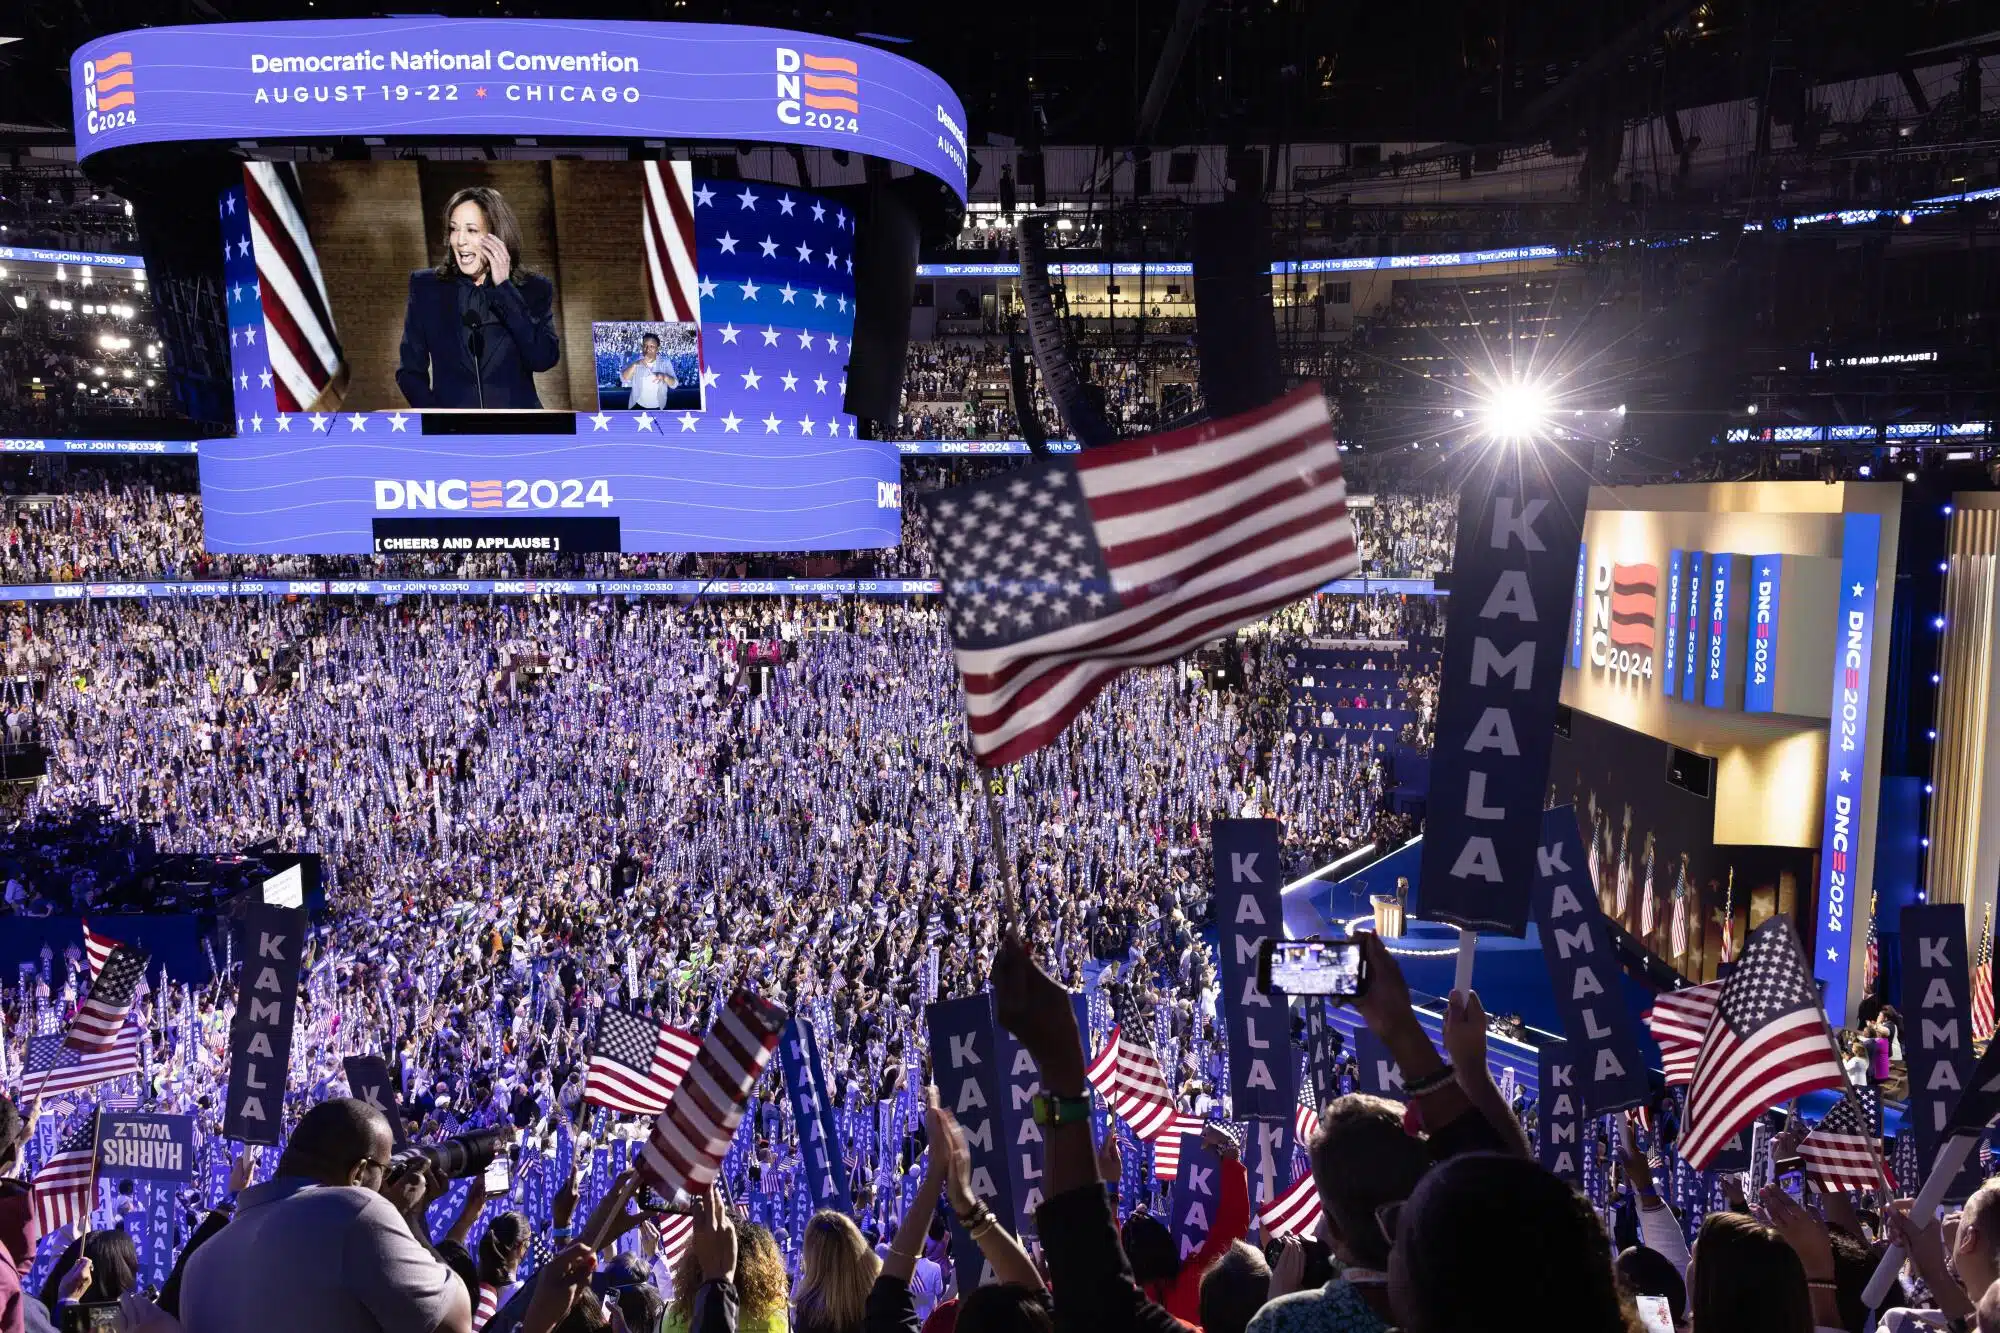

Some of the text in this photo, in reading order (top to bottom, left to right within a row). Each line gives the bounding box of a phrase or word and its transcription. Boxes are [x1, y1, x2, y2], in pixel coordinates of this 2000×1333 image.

[251, 49, 639, 74] Democratic National Convention
[84, 61, 137, 135] DNC 2024
[254, 84, 640, 104] AUGUST 19-22 CHICAGO
[776, 47, 859, 134] DNC 2024
[32, 251, 54, 260] Text
[55, 252, 80, 262] JOIN
[82, 254, 93, 262] to
[1070, 264, 1099, 274] 2024
[1392, 254, 1460, 267] DNC 2024
[1858, 355, 1879, 365] AND
[1881, 352, 1931, 364] APPLAUSE
[5, 440, 46, 450] 2024
[64, 441, 88, 450] Text
[90, 441, 115, 451] JOIN
[117, 442, 128, 451] to
[942, 441, 1010, 452] DNC 2024
[374, 479, 614, 510] DNC 2024
[383, 537, 439, 550] CHEERS
[442, 537, 473, 550] AND
[475, 536, 551, 550] APPLAUSE
[106, 585, 146, 597] 2024
[191, 584, 215, 593] JOIN
[289, 581, 365, 594] DNC 2024
[382, 583, 470, 592] Text JOIN to 30330
[494, 582, 570, 593] DNC 2024
[607, 583, 630, 592] JOIN
[632, 583, 642, 592] to
[643, 583, 674, 592] 30330
[740, 582, 774, 593] 2024
[790, 583, 809, 592] Text
[811, 583, 834, 592] JOIN
[836, 583, 845, 592] to
[902, 582, 933, 593] DNC
[1591, 559, 1653, 679] DNC 2024
[1667, 575, 1679, 670] DNC 2024
[1687, 577, 1699, 675] DNC 2024
[1710, 579, 1725, 681] DNC 2024
[1753, 581, 1772, 685] DNC 2024
[1449, 496, 1548, 883] KAMALA
[1840, 610, 1865, 752] DNC 2024
[1827, 794, 1851, 932] DNC 2024
[1231, 852, 1277, 1091] KAMALA
[1536, 841, 1627, 1082] KAMALA
[239, 931, 288, 1121] KAMALA
[1918, 936, 1966, 1172] KAMA
[843, 1097, 852, 1131] KAMAL
[909, 1074, 917, 1124] OKLAHOMA
[113, 1122, 171, 1140] WALZ
[595, 1106, 607, 1134] AMALA
[790, 1038, 840, 1199] KAMALA
[1009, 1030, 1044, 1215] AMALA
[1551, 1064, 1575, 1173] KAMA
[102, 1138, 183, 1171] HARRIS
[731, 1145, 739, 1177] KAMA
[949, 1030, 1000, 1287] KAMAA
[213, 1174, 225, 1205] KAM
[545, 1166, 553, 1215] KAMAL
[596, 1155, 605, 1200] KAMAL
[1676, 1157, 1686, 1203] AMALA
[528, 1178, 537, 1226] KAMA
[795, 1182, 807, 1241] KAMALA
[905, 1182, 913, 1209] KAM
[1180, 1163, 1214, 1261] KAM
[1713, 1180, 1723, 1211] KAM
[129, 1221, 143, 1256] KAM
[153, 1187, 168, 1282] KAMALA
